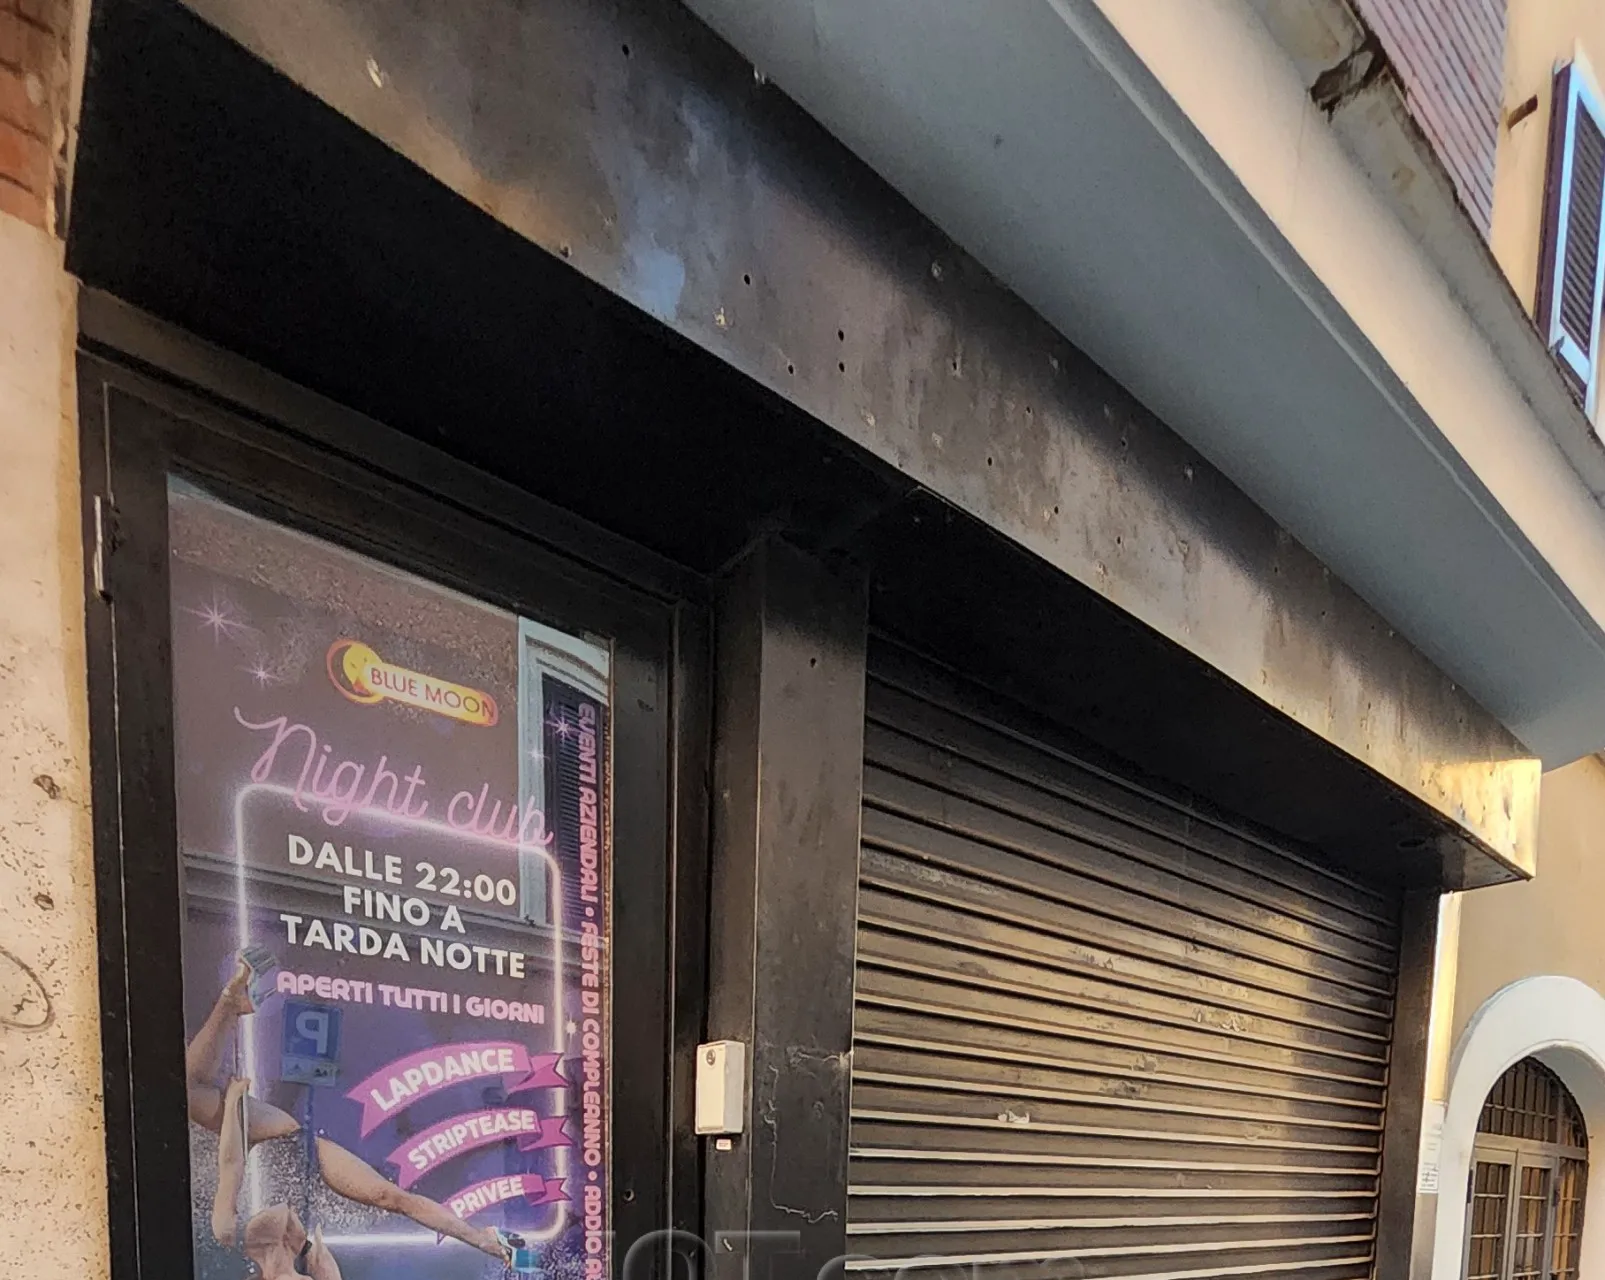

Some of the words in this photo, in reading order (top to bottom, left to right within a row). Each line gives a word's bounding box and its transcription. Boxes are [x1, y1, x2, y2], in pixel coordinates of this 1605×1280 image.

[371, 667, 418, 696] BLUE
[425, 683, 494, 717] MOON
[234, 706, 429, 826] Night
[578, 702, 598, 784] EVENTI
[288, 834, 403, 884] DALLE
[415, 862, 516, 906] 22:00
[578, 786, 599, 903] AZIENDALI
[343, 885, 430, 926] FINO
[440, 905, 466, 934] A
[280, 914, 410, 962] TARDA
[420, 937, 525, 979] NOTTE
[581, 922, 600, 988] FESTE
[276, 970, 373, 1004] APERTI
[378, 983, 448, 1014] TUTTI
[452, 993, 461, 1014] I
[465, 996, 545, 1025] GIORNI
[581, 991, 600, 1014] DI
[370, 1048, 515, 1111] LAPDANCE
[581, 1015, 602, 1166] COMPLEANNO
[408, 1109, 535, 1170] STRIPTEASE
[452, 1176, 525, 1218] PRIVEE
[584, 1186, 602, 1254] ADDIO
